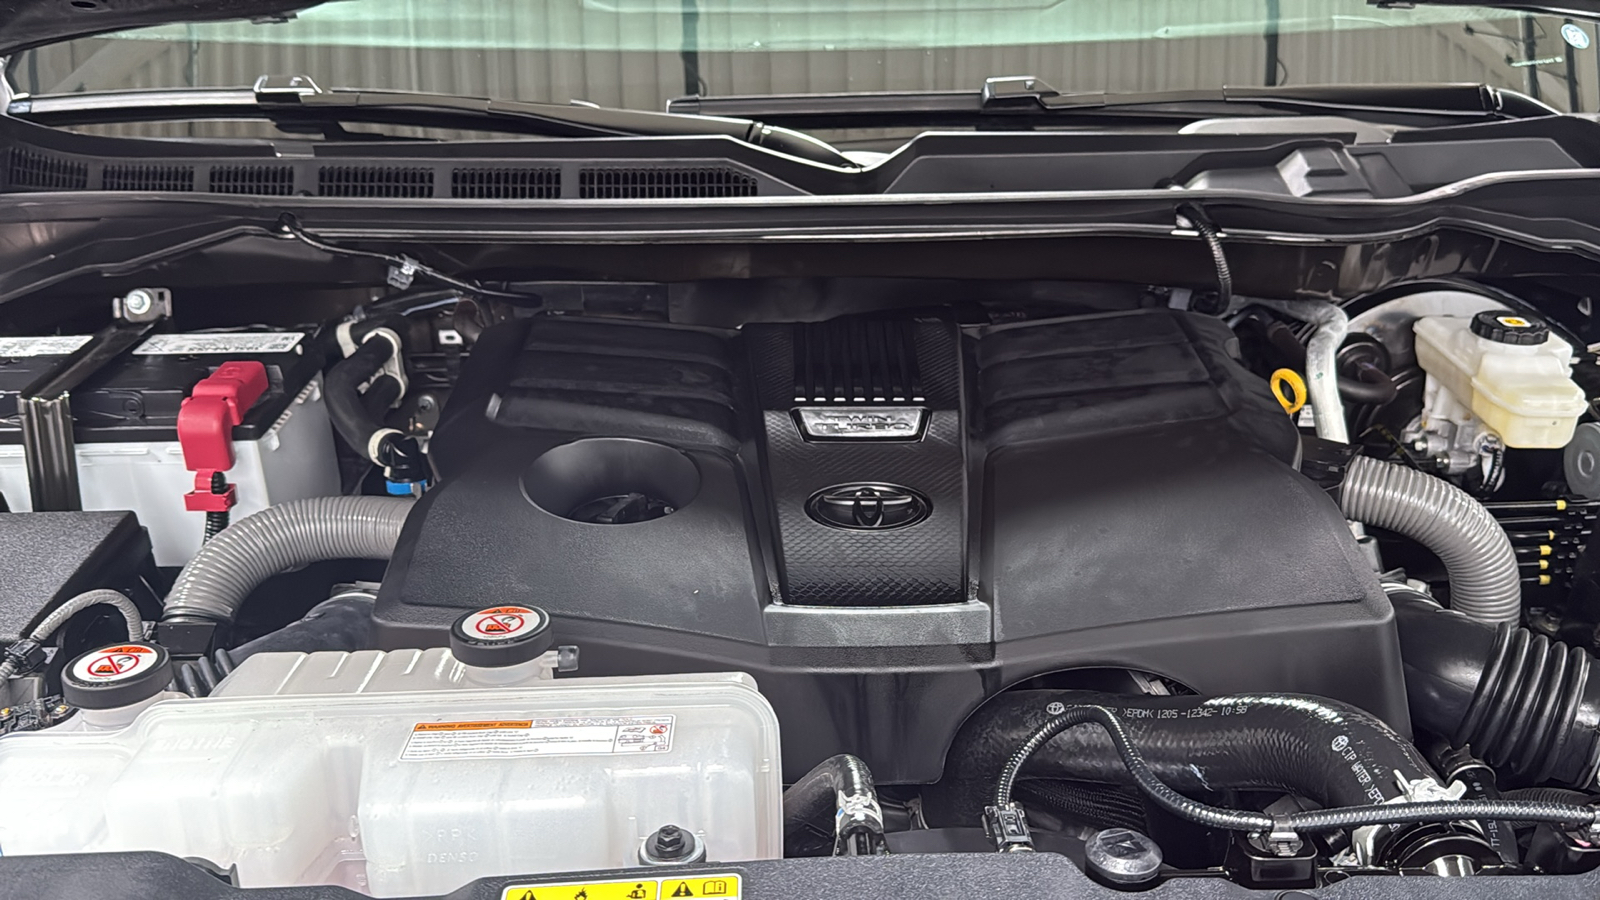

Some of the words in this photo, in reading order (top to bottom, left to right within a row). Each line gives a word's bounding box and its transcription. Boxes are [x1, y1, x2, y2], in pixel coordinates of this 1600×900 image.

[824, 414, 893, 423] TWIN
[813, 422, 915, 433] TURBO
[1157, 709, 1179, 719] 1205
[1341, 746, 1357, 762] CIP
[1351, 760, 1371, 786] WATER
[1364, 783, 1385, 806] >EPD
[427, 851, 479, 864] DENSO
